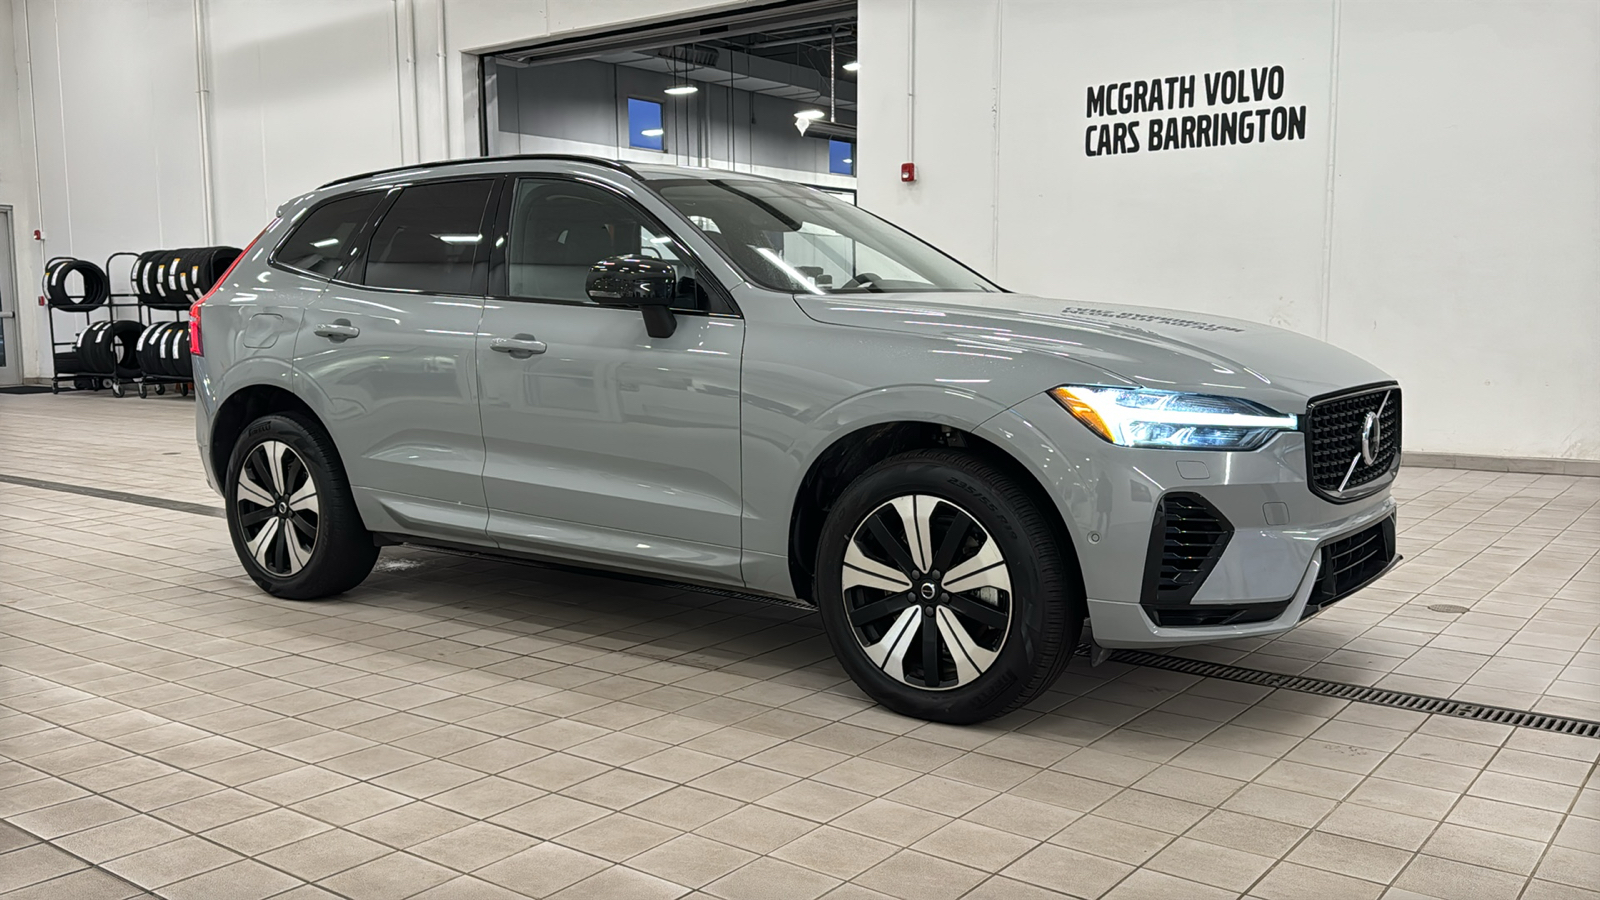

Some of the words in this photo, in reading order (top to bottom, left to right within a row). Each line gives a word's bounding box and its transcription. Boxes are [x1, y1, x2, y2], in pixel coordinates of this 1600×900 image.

[1086, 74, 1196, 119] MCGRATH
[1204, 65, 1285, 106] VOLVO
[1085, 120, 1140, 157] CARS
[1147, 105, 1307, 152] BARRINGTON
